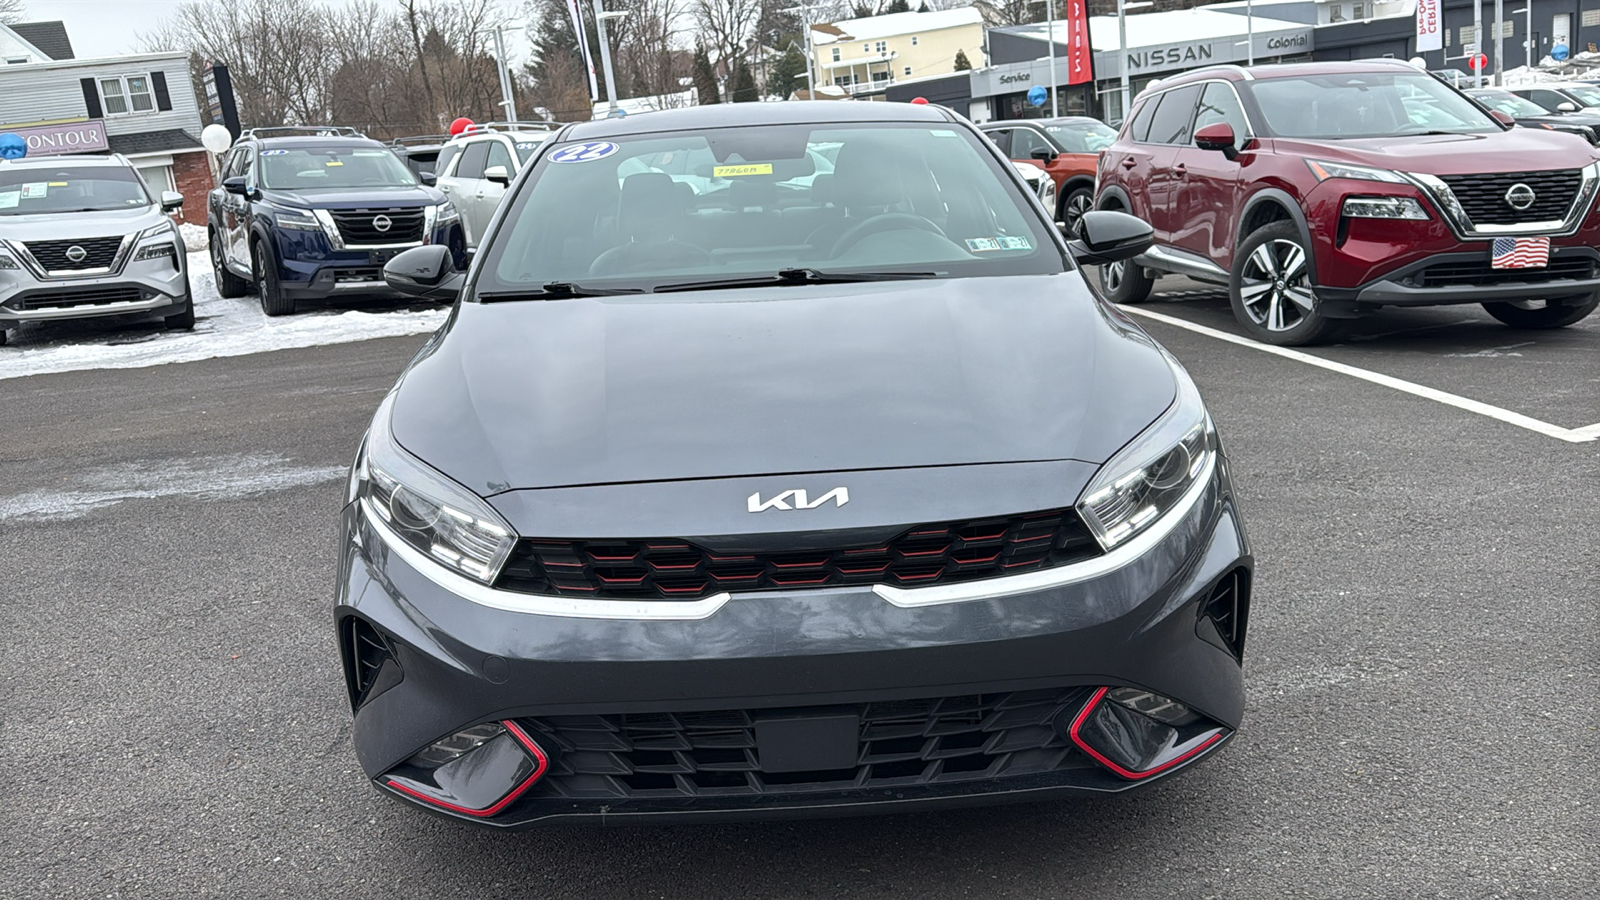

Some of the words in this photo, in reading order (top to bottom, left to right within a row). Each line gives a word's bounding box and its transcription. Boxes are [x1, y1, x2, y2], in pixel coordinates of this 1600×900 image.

[1267, 34, 1307, 49] Colonial
[1127, 43, 1212, 69] NISSAN
[1000, 72, 1030, 84] Service
[22, 129, 99, 149] ONTOUR
[557, 142, 610, 161] 22
[747, 486, 849, 512] KIA
